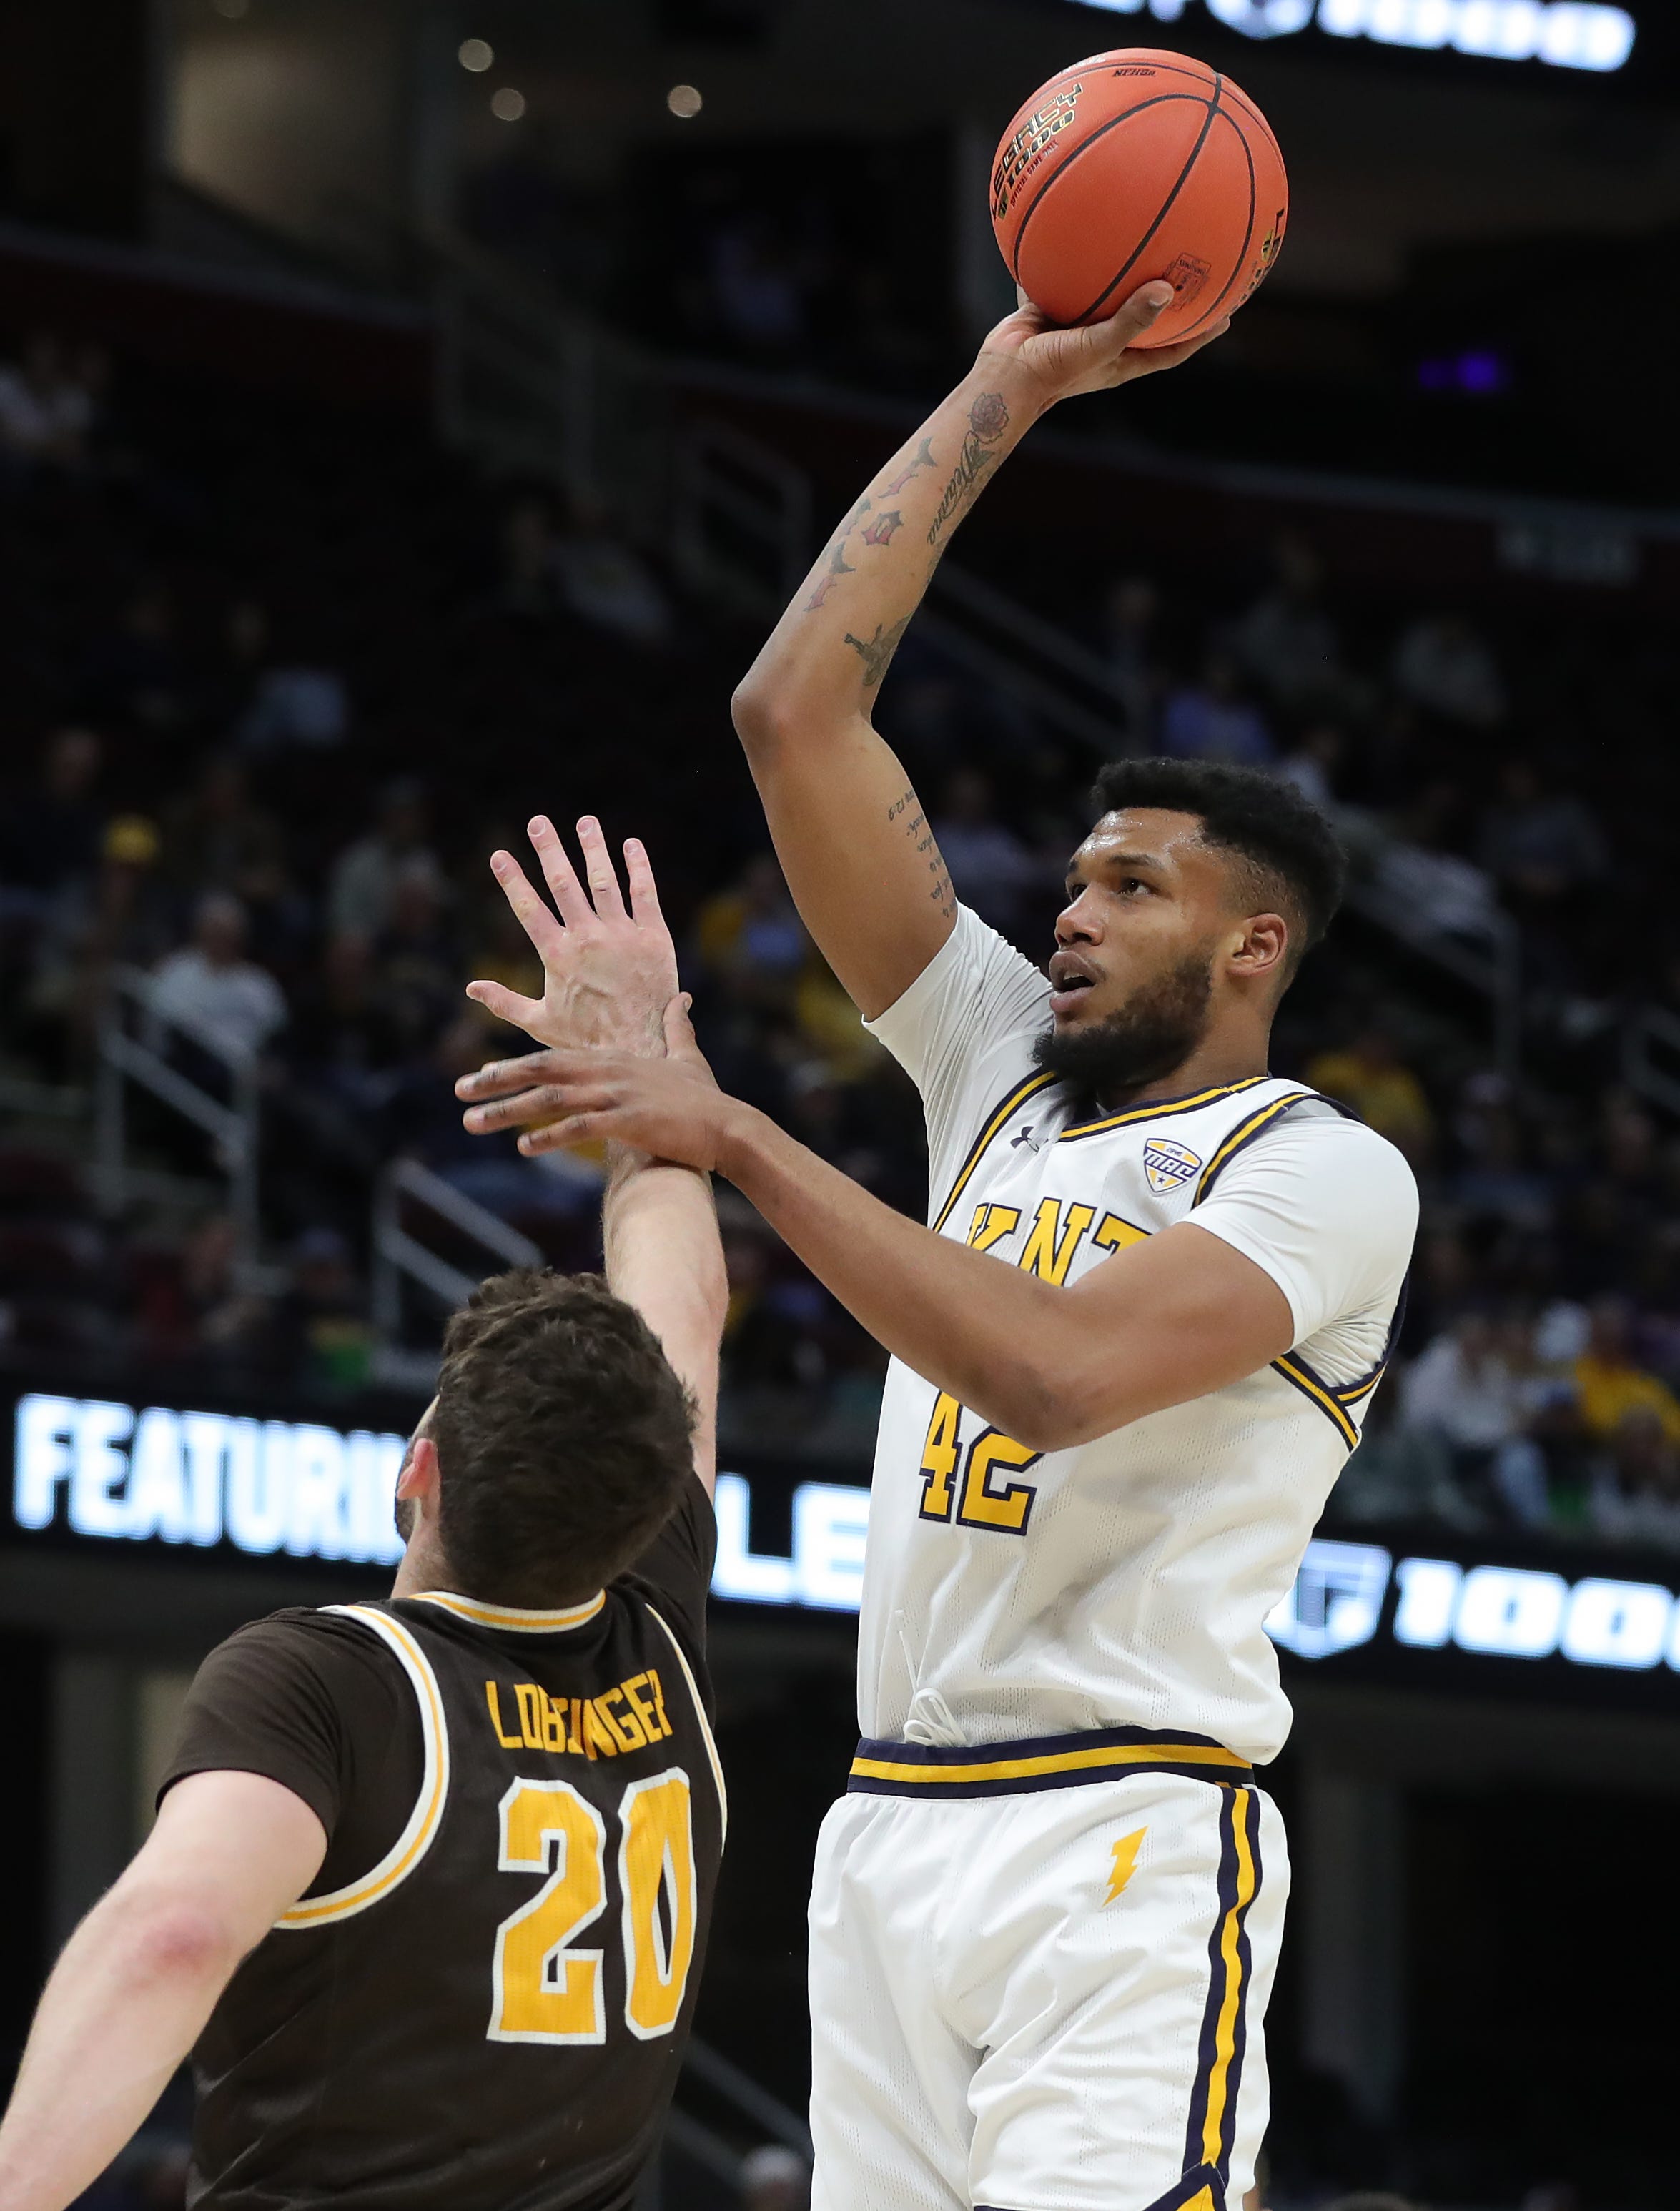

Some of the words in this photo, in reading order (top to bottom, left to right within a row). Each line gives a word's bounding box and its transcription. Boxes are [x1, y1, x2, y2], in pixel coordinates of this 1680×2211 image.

[1144, 1149, 1195, 1181] MAC
[919, 1390, 1044, 1535] 42
[1393, 1555, 1680, 1674] 100
[486, 1766, 698, 2044] 20
